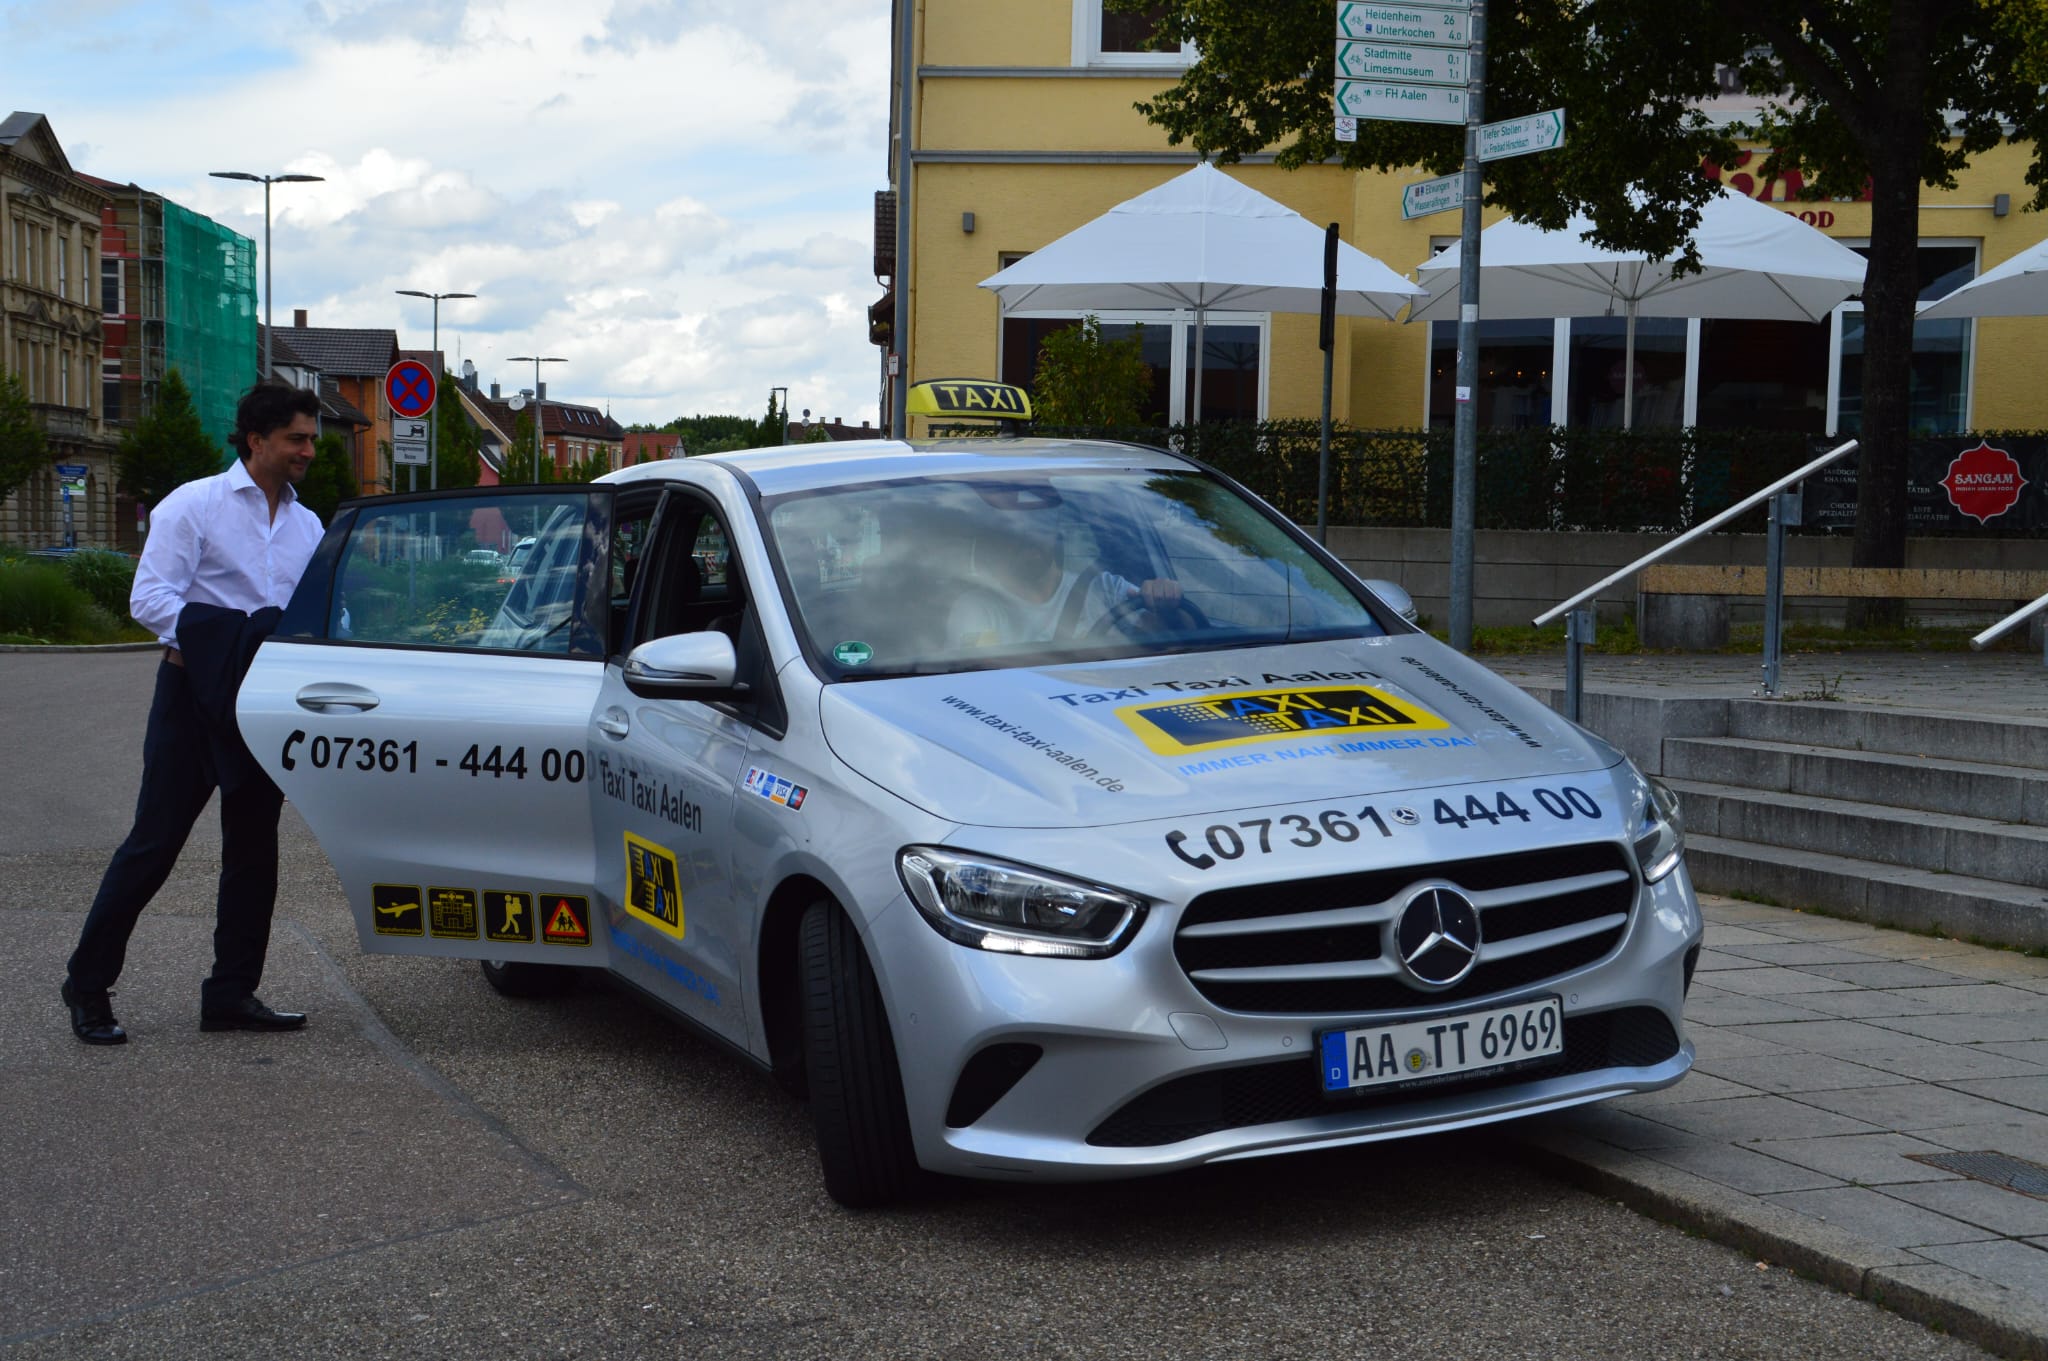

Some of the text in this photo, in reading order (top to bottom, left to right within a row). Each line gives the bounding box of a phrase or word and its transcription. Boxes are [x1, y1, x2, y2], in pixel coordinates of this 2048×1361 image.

[1365, 9, 1455, 25] Heidenheim 26
[1376, 25, 1435, 39] Unterkochen
[1364, 48, 1412, 61] Stadtmitte
[1364, 62, 1434, 78] Limesmuseum
[1385, 88, 1399, 99] FH
[1401, 89, 1427, 101] Aalen
[1483, 127, 1499, 140] Tiefer
[1501, 124, 1522, 136] Stollen
[940, 386, 1017, 410] TAXI
[1955, 473, 2014, 484] SANGAM
[1048, 670, 1382, 707] Taxi Taxi Aalen
[942, 695, 1125, 793] www.taxi-taxi-aalen.de
[310, 735, 418, 774] 07361
[459, 743, 528, 779] 444
[541, 748, 586, 783] 00
[1178, 736, 1478, 777] IMMER NAH IMMER DA!
[600, 759, 702, 834] Taxi Taxi Aalen
[1204, 786, 1603, 861] 07361 444 00
[1331, 1005, 1557, 1080] D AA TT 6969
